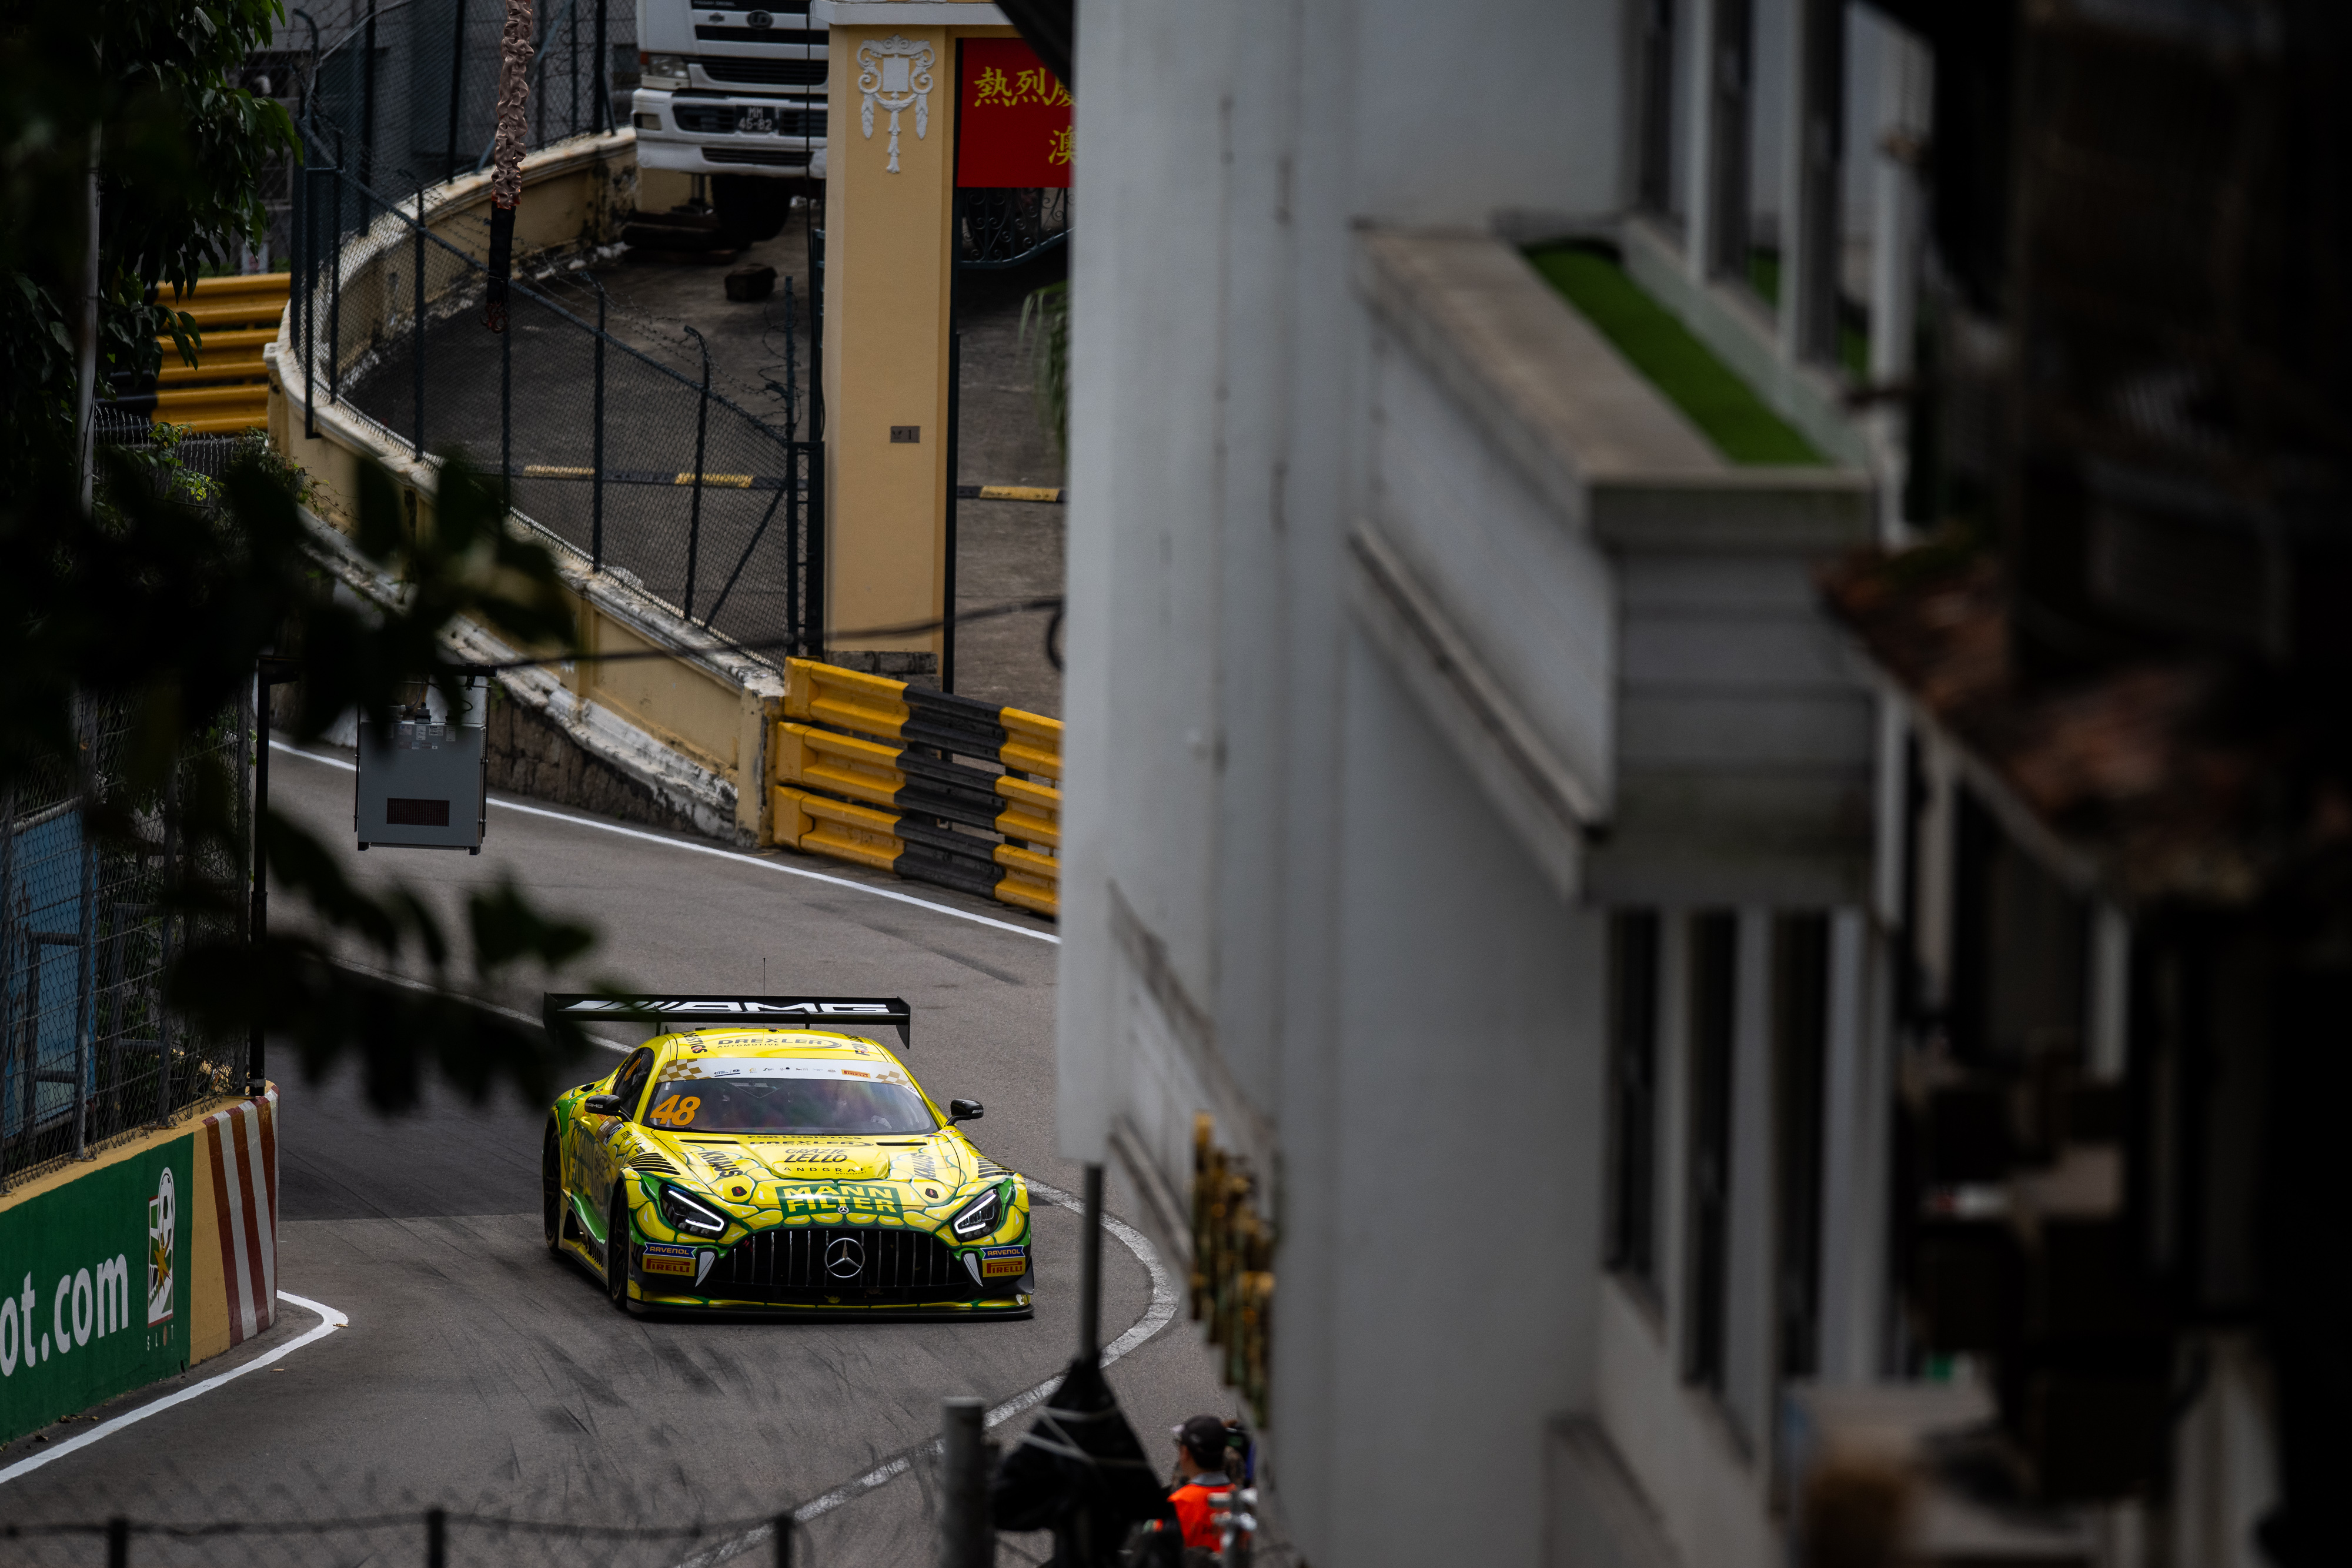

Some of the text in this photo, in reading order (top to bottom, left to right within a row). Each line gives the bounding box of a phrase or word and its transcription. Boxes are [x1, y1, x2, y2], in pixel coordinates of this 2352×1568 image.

[748, 106, 763, 118] MM
[669, 1001, 890, 1013] AMG
[650, 1094, 701, 1126] 48
[698, 1151, 743, 1177] KNAUS
[784, 1153, 847, 1163] LELLO
[910, 1153, 936, 1181] KNAUS
[783, 1185, 893, 1199] MANN
[786, 1196, 897, 1213] FILTER
[650, 1246, 689, 1255] RAVENOL
[646, 1258, 690, 1273] PIRELLI
[987, 1261, 1023, 1274] PIRELLI
[0, 1253, 128, 1376] ot.com
